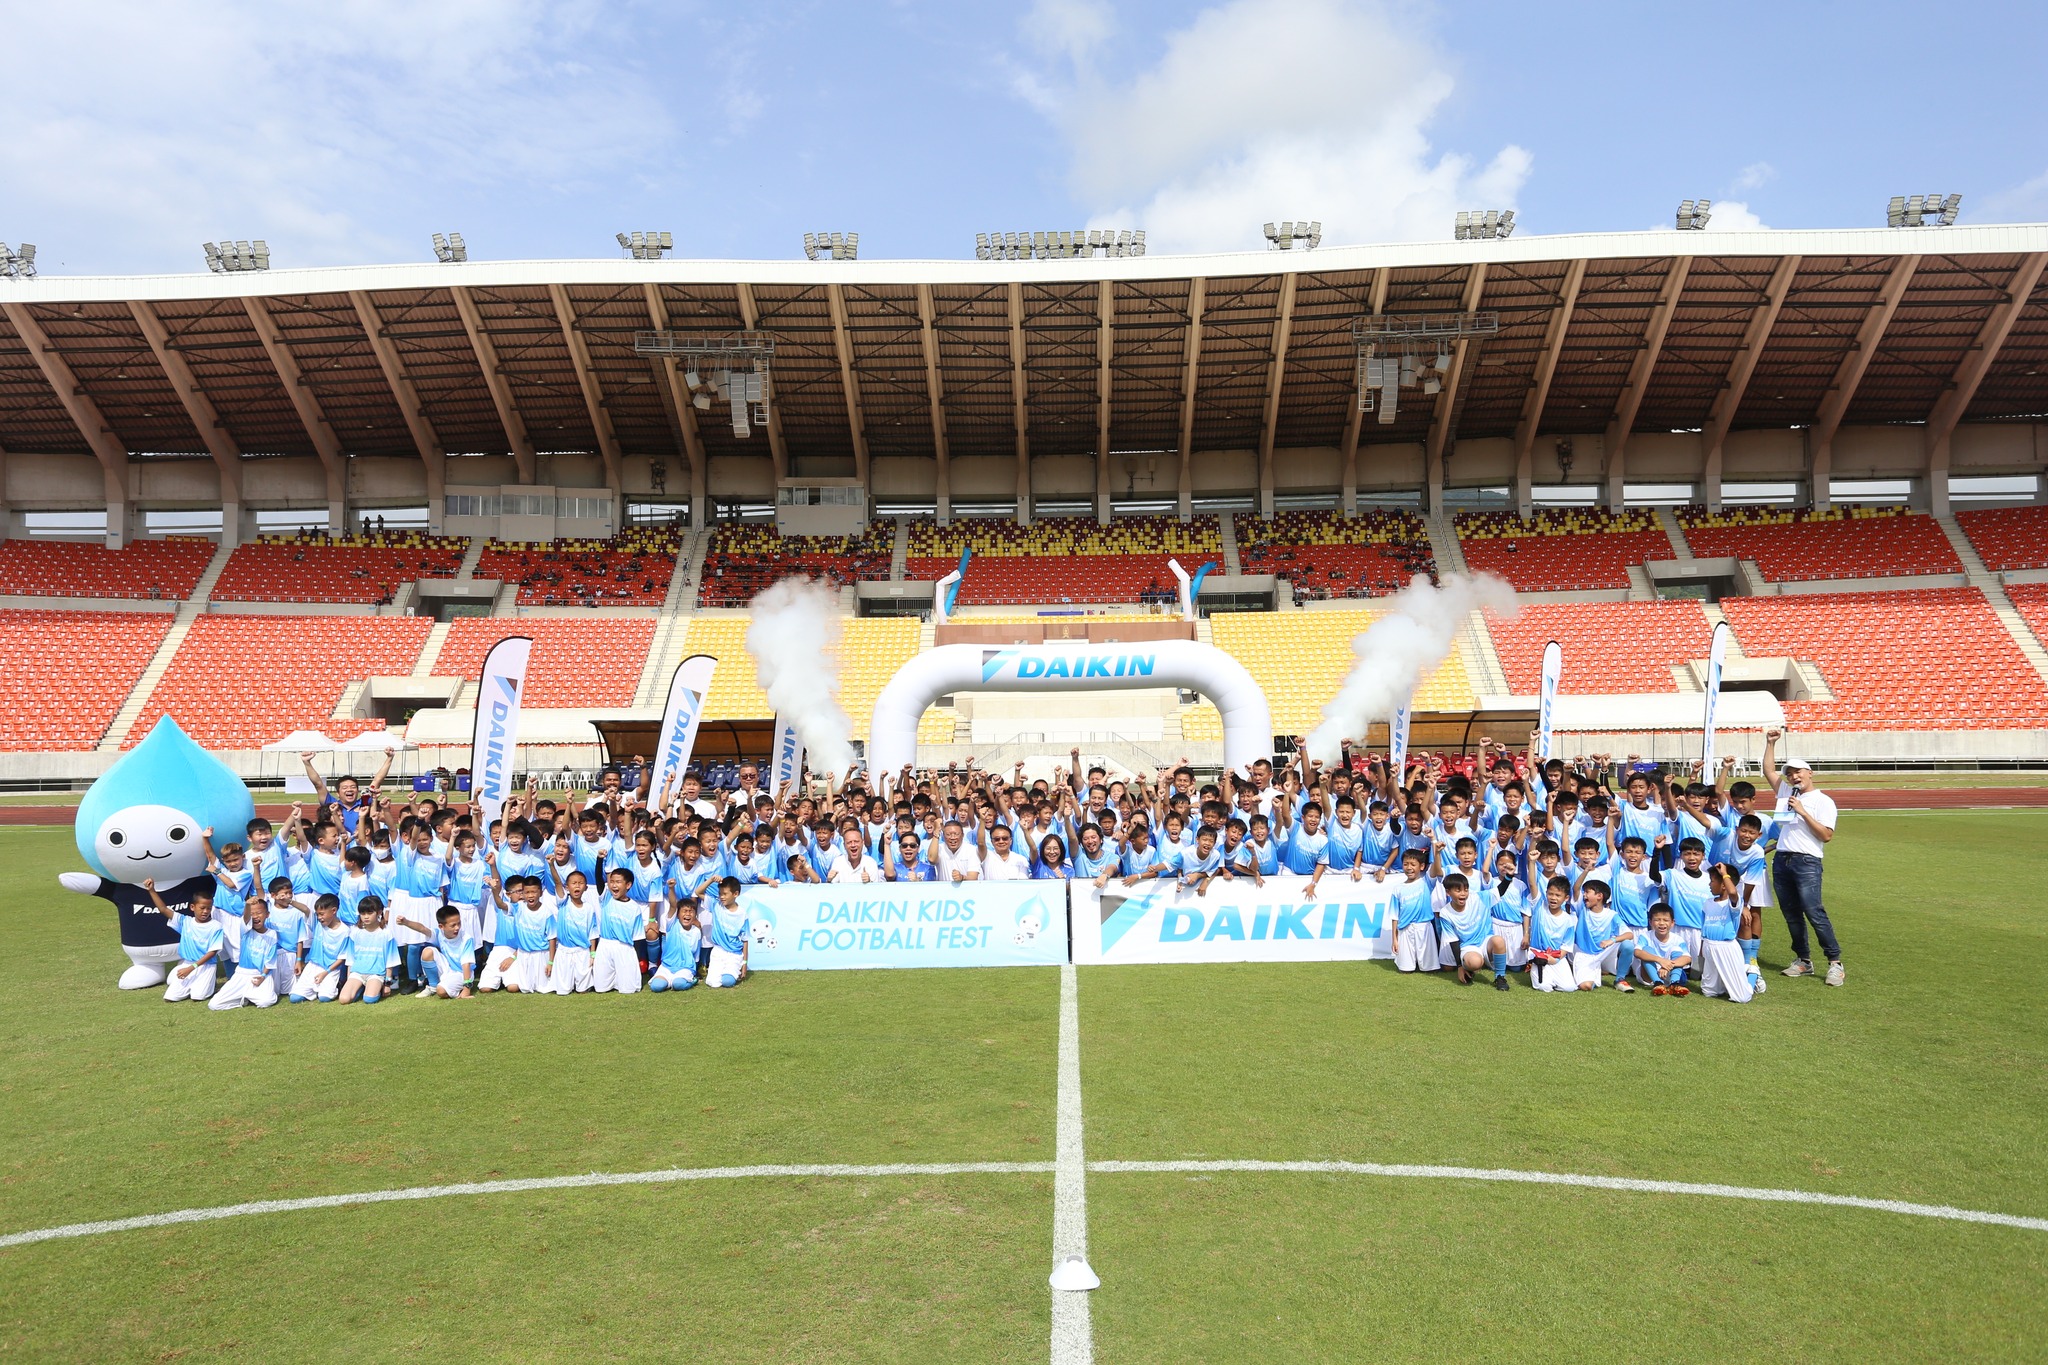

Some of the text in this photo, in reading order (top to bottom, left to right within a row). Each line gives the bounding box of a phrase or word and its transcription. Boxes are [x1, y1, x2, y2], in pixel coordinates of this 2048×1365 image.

[1017, 654, 1156, 678] DAIKIN
[483, 700, 509, 801] DAIKIN
[780, 726, 797, 781] AIKIN
[143, 901, 189, 914] DAKIN
[816, 899, 976, 924] DAIKIN KIDS
[1158, 903, 1386, 943] DAIKIN
[797, 926, 993, 952] FOOTBALL FEST
